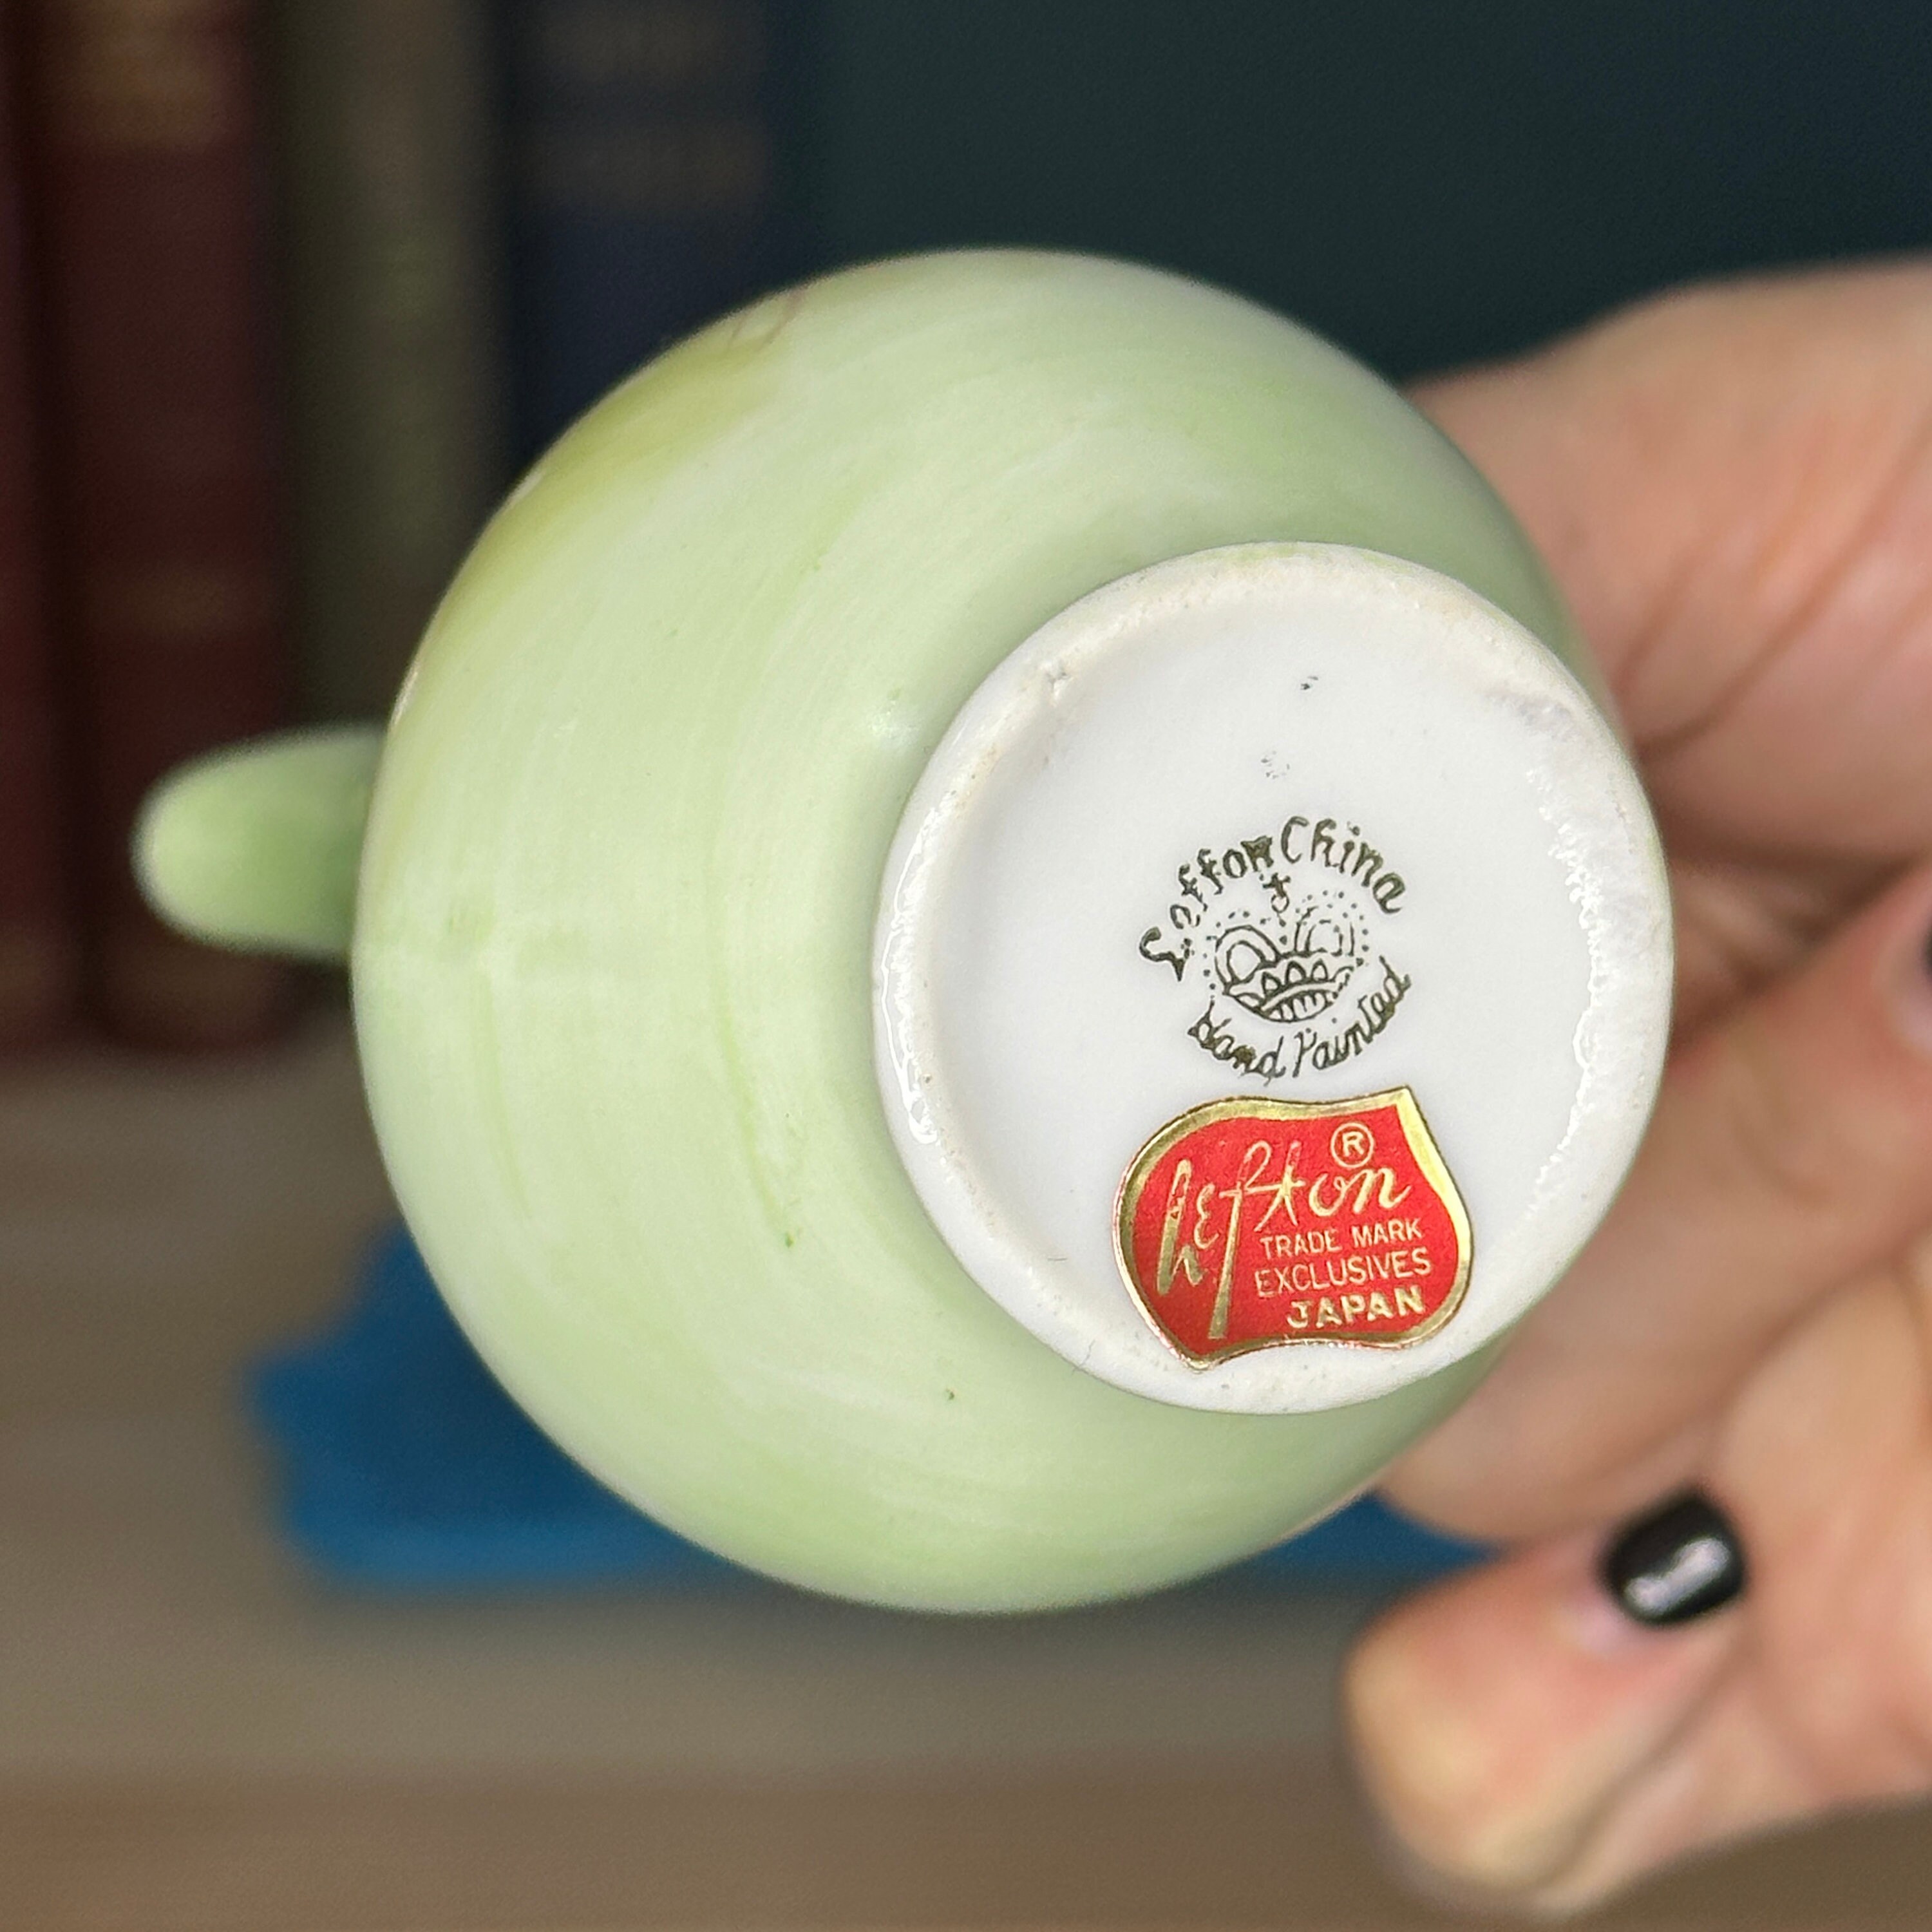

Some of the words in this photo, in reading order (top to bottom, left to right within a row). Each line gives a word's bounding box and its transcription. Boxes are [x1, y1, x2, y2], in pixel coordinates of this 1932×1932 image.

[1280, 815, 1406, 914] China
[1187, 999, 1287, 1087] Hand
[1259, 1227, 1341, 1260] TRADE
[1351, 1218, 1423, 1245] MARK
[1254, 1247, 1432, 1298] EXCLUSIVES
[1286, 1285, 1425, 1329] JAPAN
